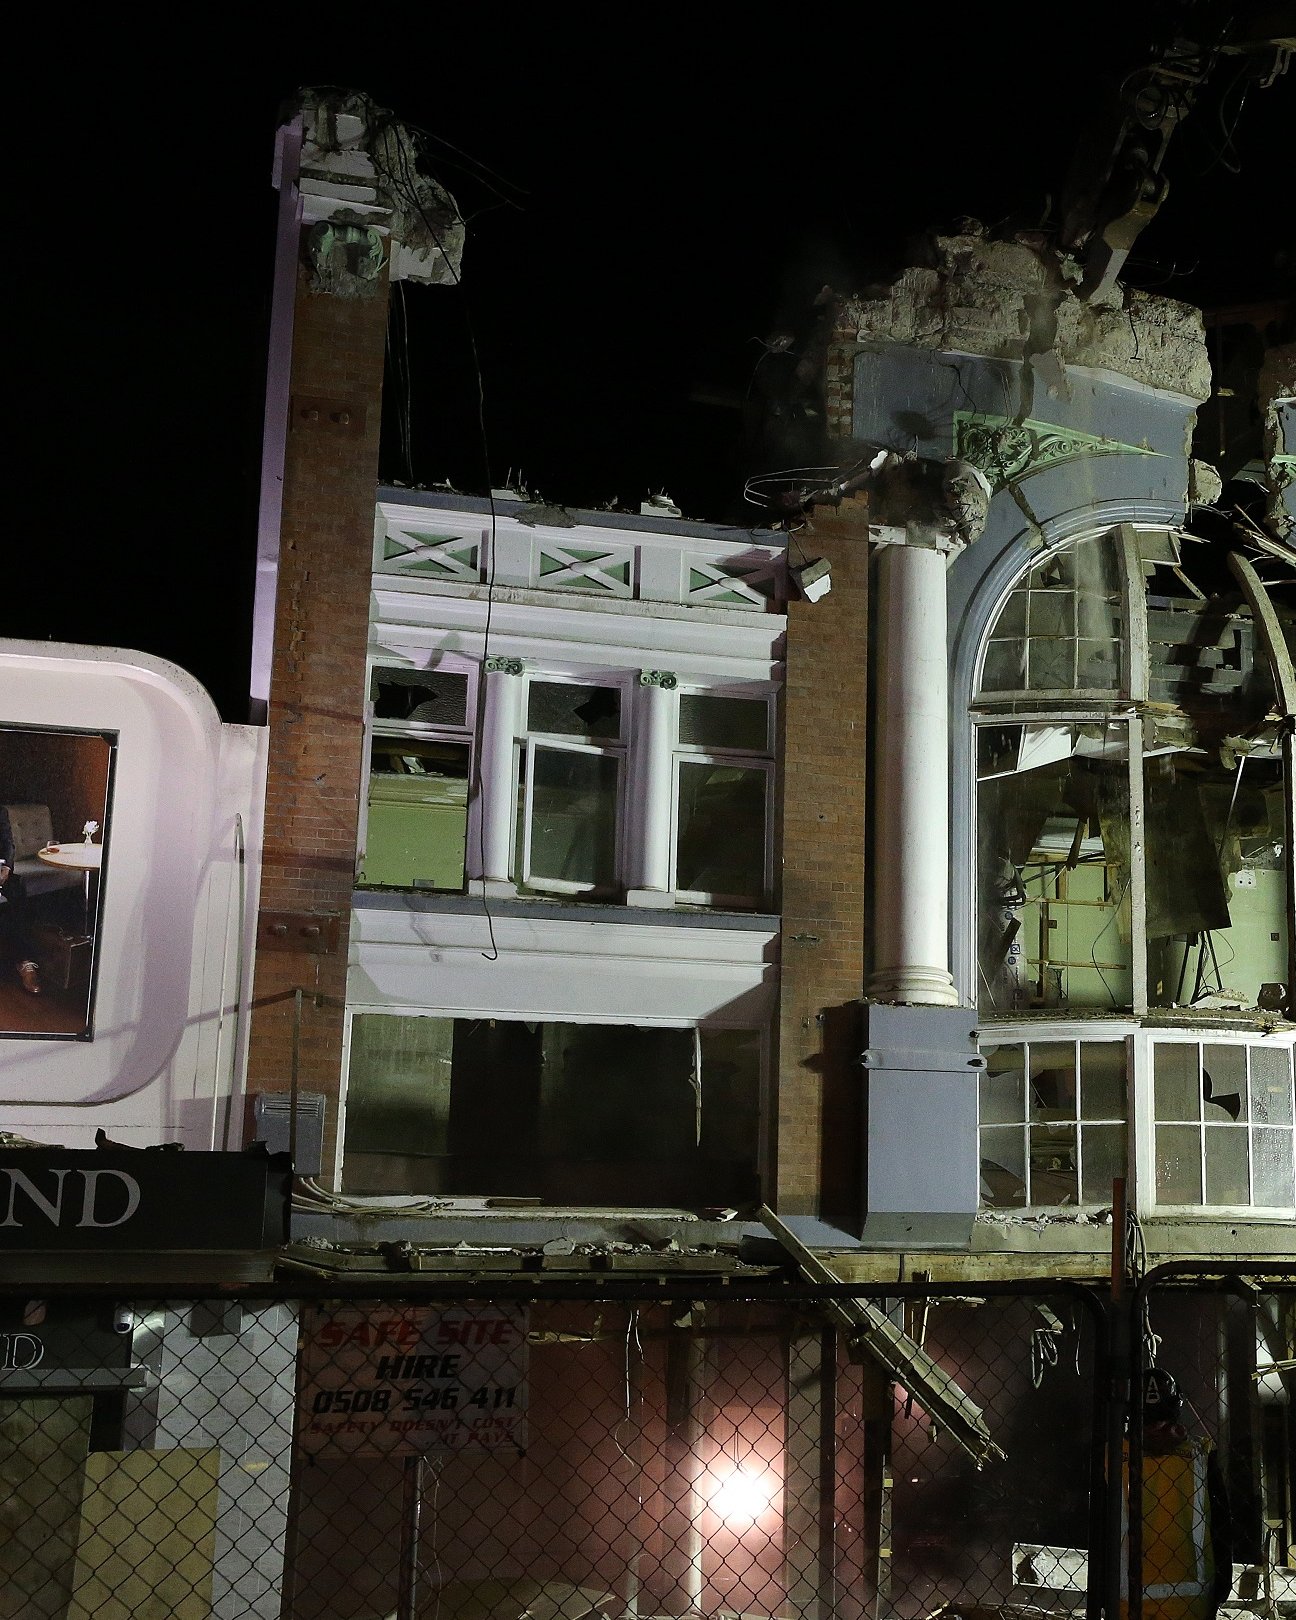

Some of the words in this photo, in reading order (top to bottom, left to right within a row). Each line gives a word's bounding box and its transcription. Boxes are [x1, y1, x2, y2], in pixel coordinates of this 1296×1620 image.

[0, 1168, 141, 1227] ND
[319, 1319, 424, 1347] SAFE
[437, 1319, 513, 1345] SITE
[375, 1354, 461, 1379] HIRE
[312, 1389, 392, 1414] 0508
[402, 1387, 460, 1411] 546
[470, 1387, 517, 1409] 411
[473, 1417, 516, 1429] COST
